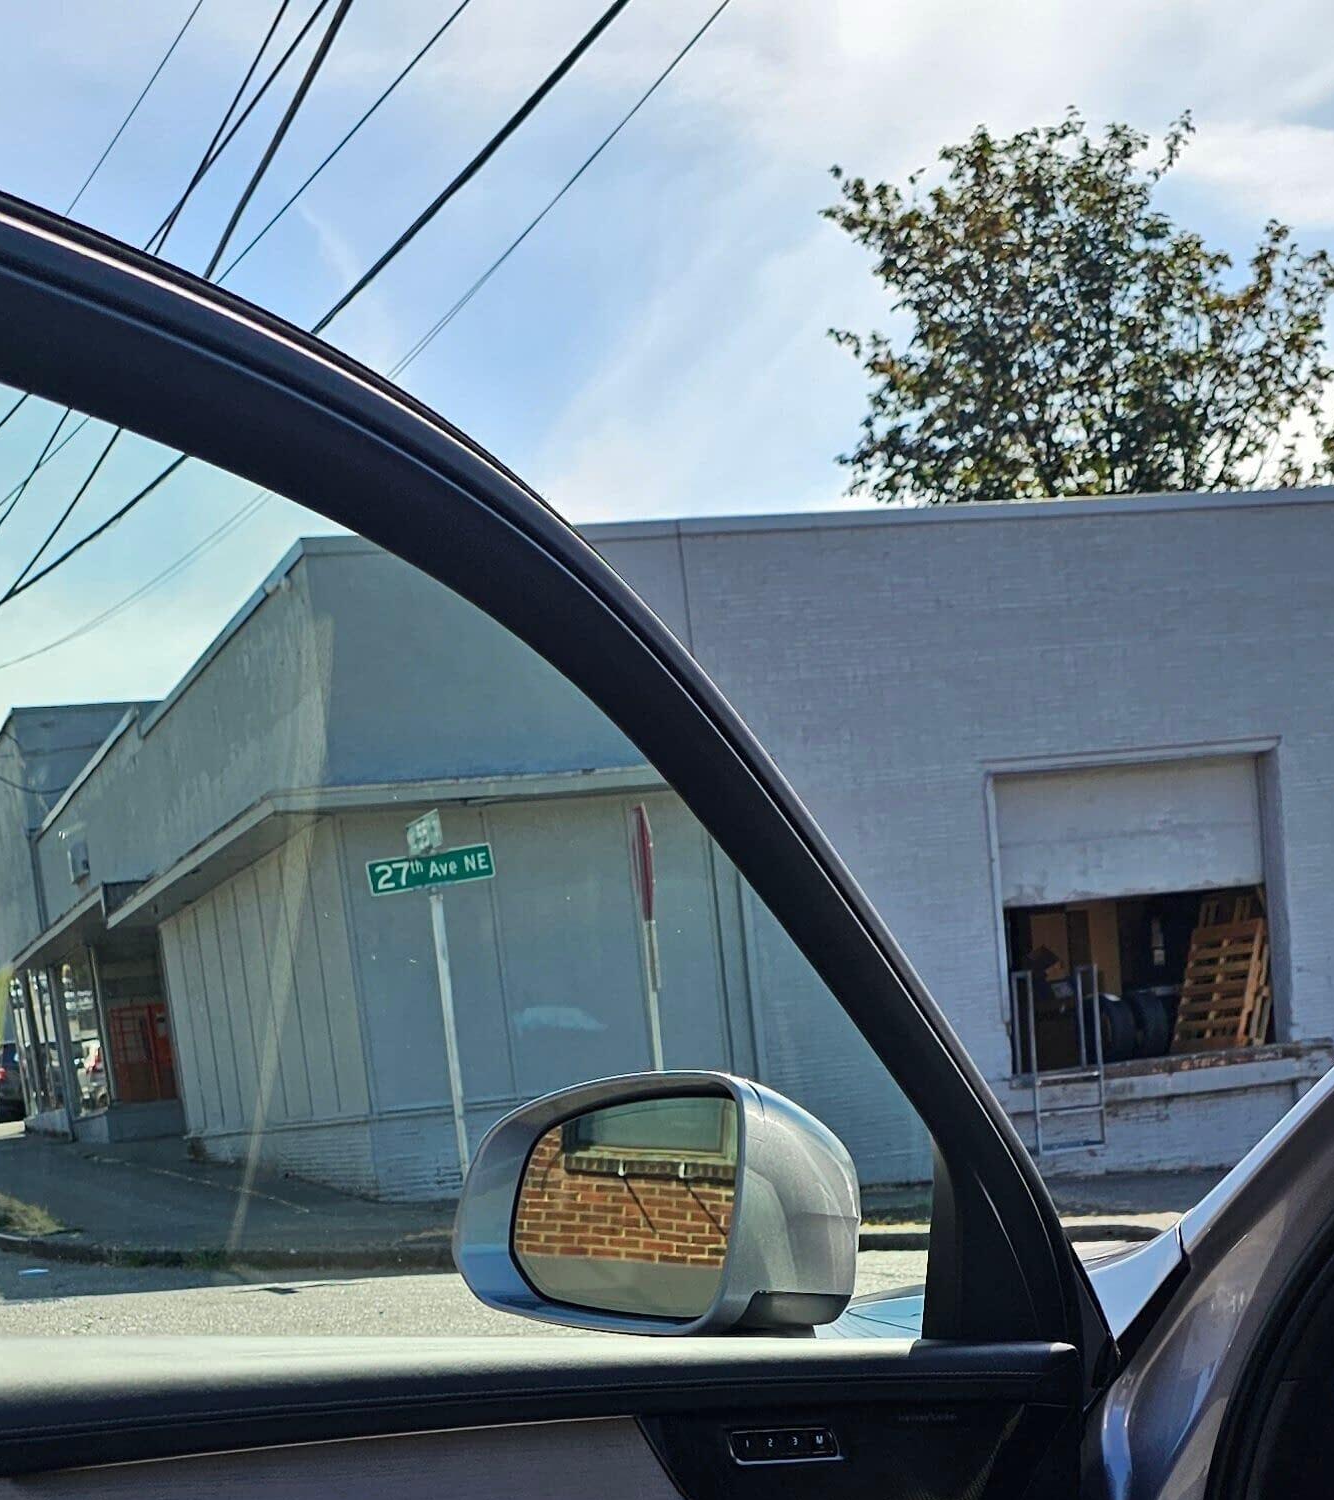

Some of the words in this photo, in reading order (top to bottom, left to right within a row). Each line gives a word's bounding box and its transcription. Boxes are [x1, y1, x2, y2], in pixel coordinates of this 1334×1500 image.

[374, 859, 424, 890] 27th
[429, 860, 458, 878] Ave
[463, 852, 490, 873] NE
[745, 1439, 750, 1448] 1
[767, 1438, 773, 1448] 2
[793, 1436, 799, 1446] 3
